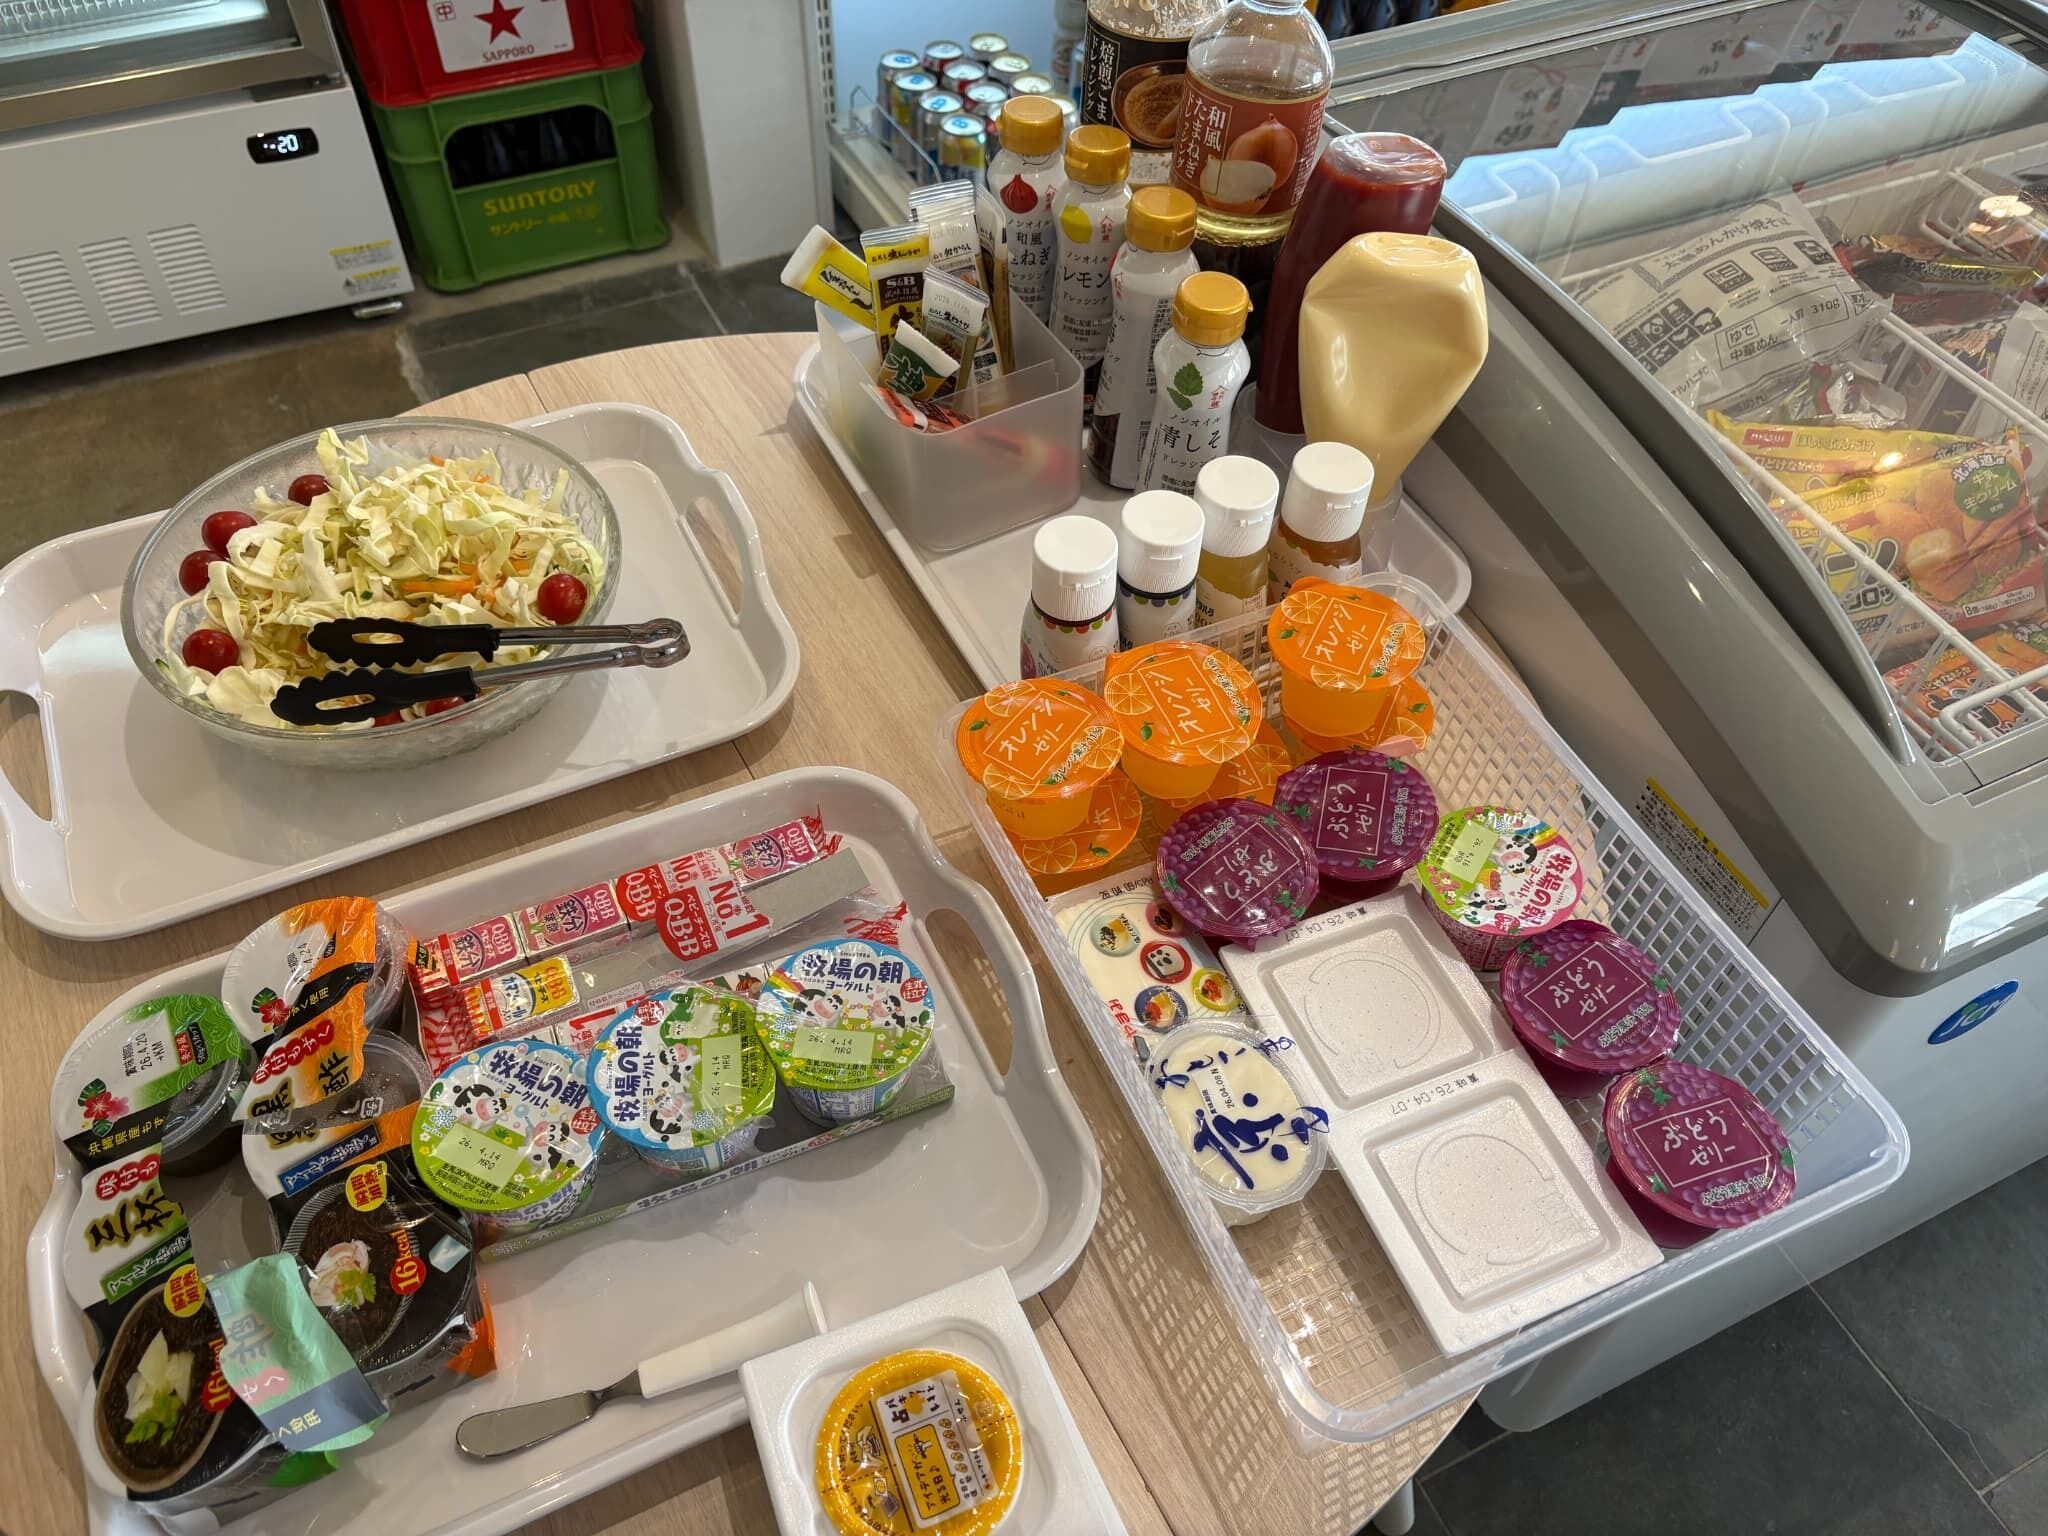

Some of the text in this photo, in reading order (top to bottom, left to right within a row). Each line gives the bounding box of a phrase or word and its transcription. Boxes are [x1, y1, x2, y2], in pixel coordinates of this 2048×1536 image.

[482, 44, 536, 62] SAPPORO
[1185, 98, 1210, 179] たまねぎ
[1202, 105, 1226, 151] 和風
[483, 180, 596, 216] SUNTORY
[1016, 232, 1042, 246] 和風
[886, 276, 916, 288] S&B
[1063, 266, 1111, 289] レモン
[1729, 325, 1754, 343] ゆで
[1729, 334, 1779, 362] 中華めん
[1161, 424, 1221, 453] 青しそ
[1963, 479, 2017, 510] 生クリーム
[1315, 602, 1353, 664] オレンジ
[1344, 627, 1370, 657] ゼリー
[1145, 668, 1206, 737] オレンジ
[1186, 676, 1214, 715] ゼリー
[1000, 700, 1054, 760] オレンジ
[1033, 719, 1068, 756] ゼリー
[1327, 782, 1356, 840] ぶどう
[1356, 792, 1378, 834] ゼリー
[751, 835, 780, 871] 鉄分
[1214, 843, 1251, 876] ゼリー
[1223, 848, 1279, 903] ぶどう
[1516, 863, 1545, 901] ヨーグルト
[1519, 851, 1573, 927] 牧場の朝
[555, 897, 584, 934] 鉄分
[685, 891, 712, 950] ベビーチーズは
[709, 877, 769, 940] No.1
[1285, 912, 1343, 943] 26.04.07
[452, 933, 481, 970] 鉄分
[801, 953, 905, 985] 牧場の朝
[825, 978, 875, 994] ヨーグルト
[1549, 956, 1607, 1010] ぶどう
[1579, 983, 1618, 1017] ゼリー
[489, 1047, 588, 1110] 牧場の朝
[614, 1026, 643, 1122] 牧場の朝
[643, 1050, 656, 1097] ヨーグルト
[503, 1081, 552, 1110] ヨーグルト
[1391, 1082, 1455, 1116] 26.04.07
[1663, 1108, 1730, 1153] ぶどう
[1689, 1141, 1737, 1168] ゼリー
[391, 1229, 420, 1291] 16kcal
[912, 1459, 936, 1511] アイデアが
